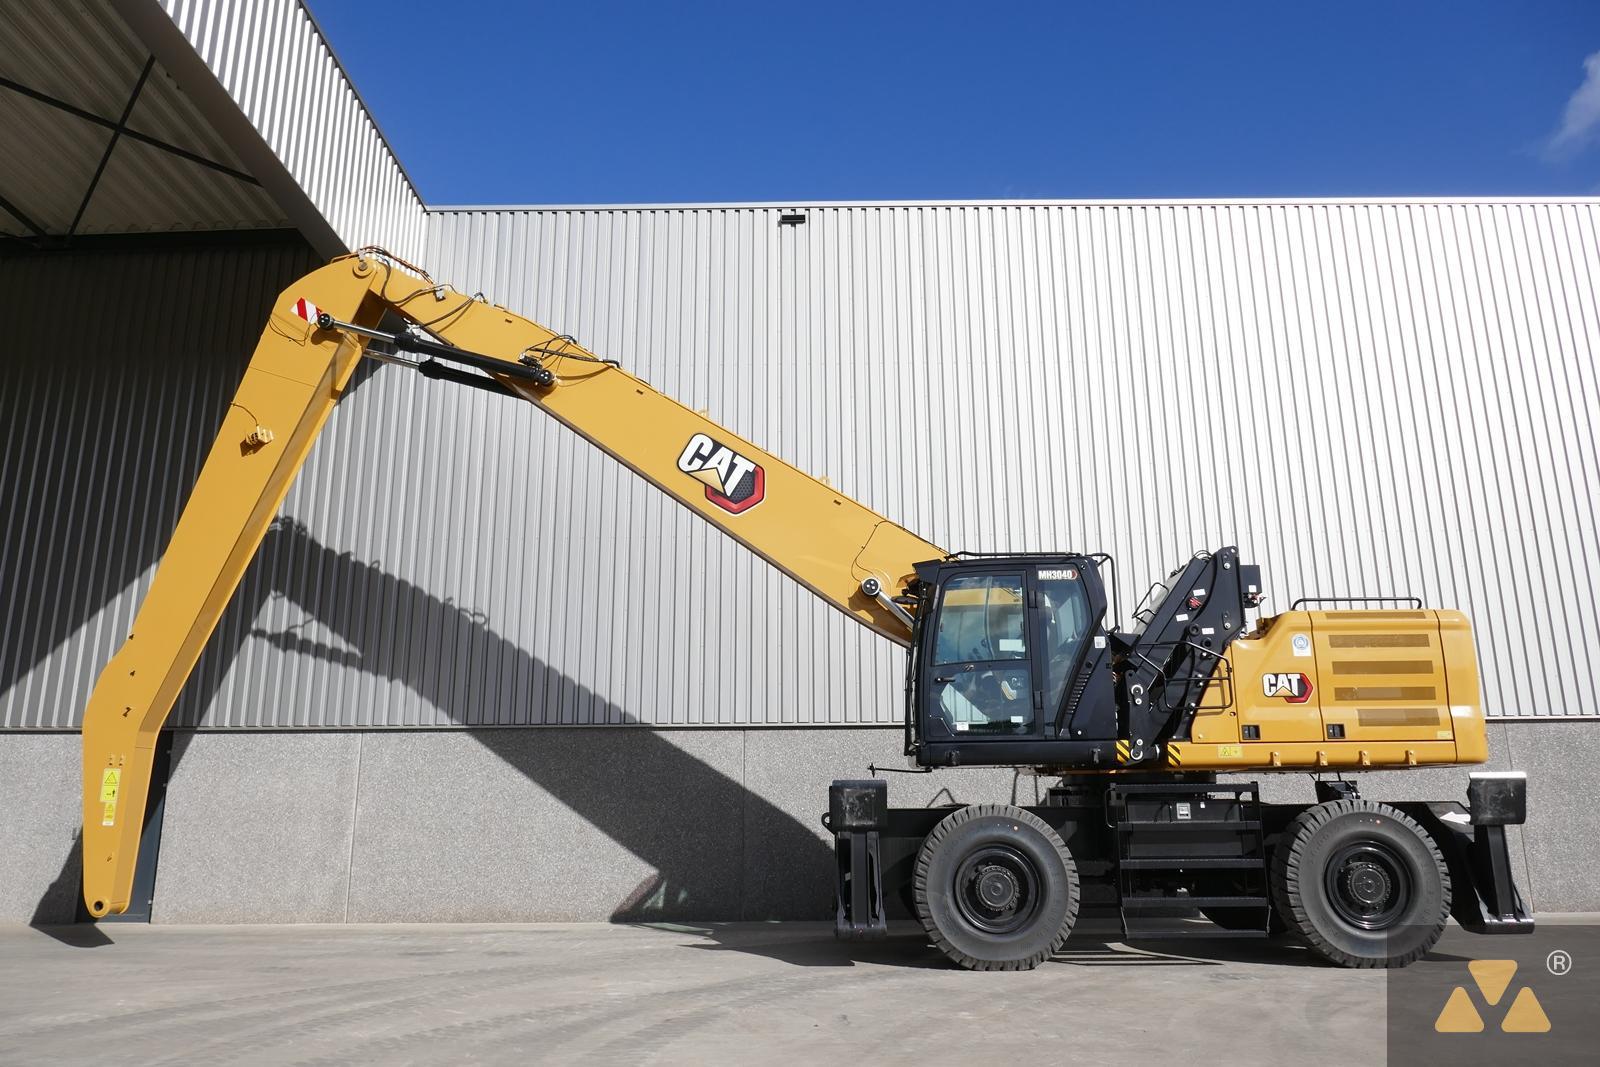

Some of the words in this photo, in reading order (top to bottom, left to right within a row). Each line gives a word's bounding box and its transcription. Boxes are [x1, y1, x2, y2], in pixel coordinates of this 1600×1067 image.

[678, 433, 757, 497] CAT
[1038, 569, 1072, 580] MH3040
[1262, 673, 1301, 697] CAT
